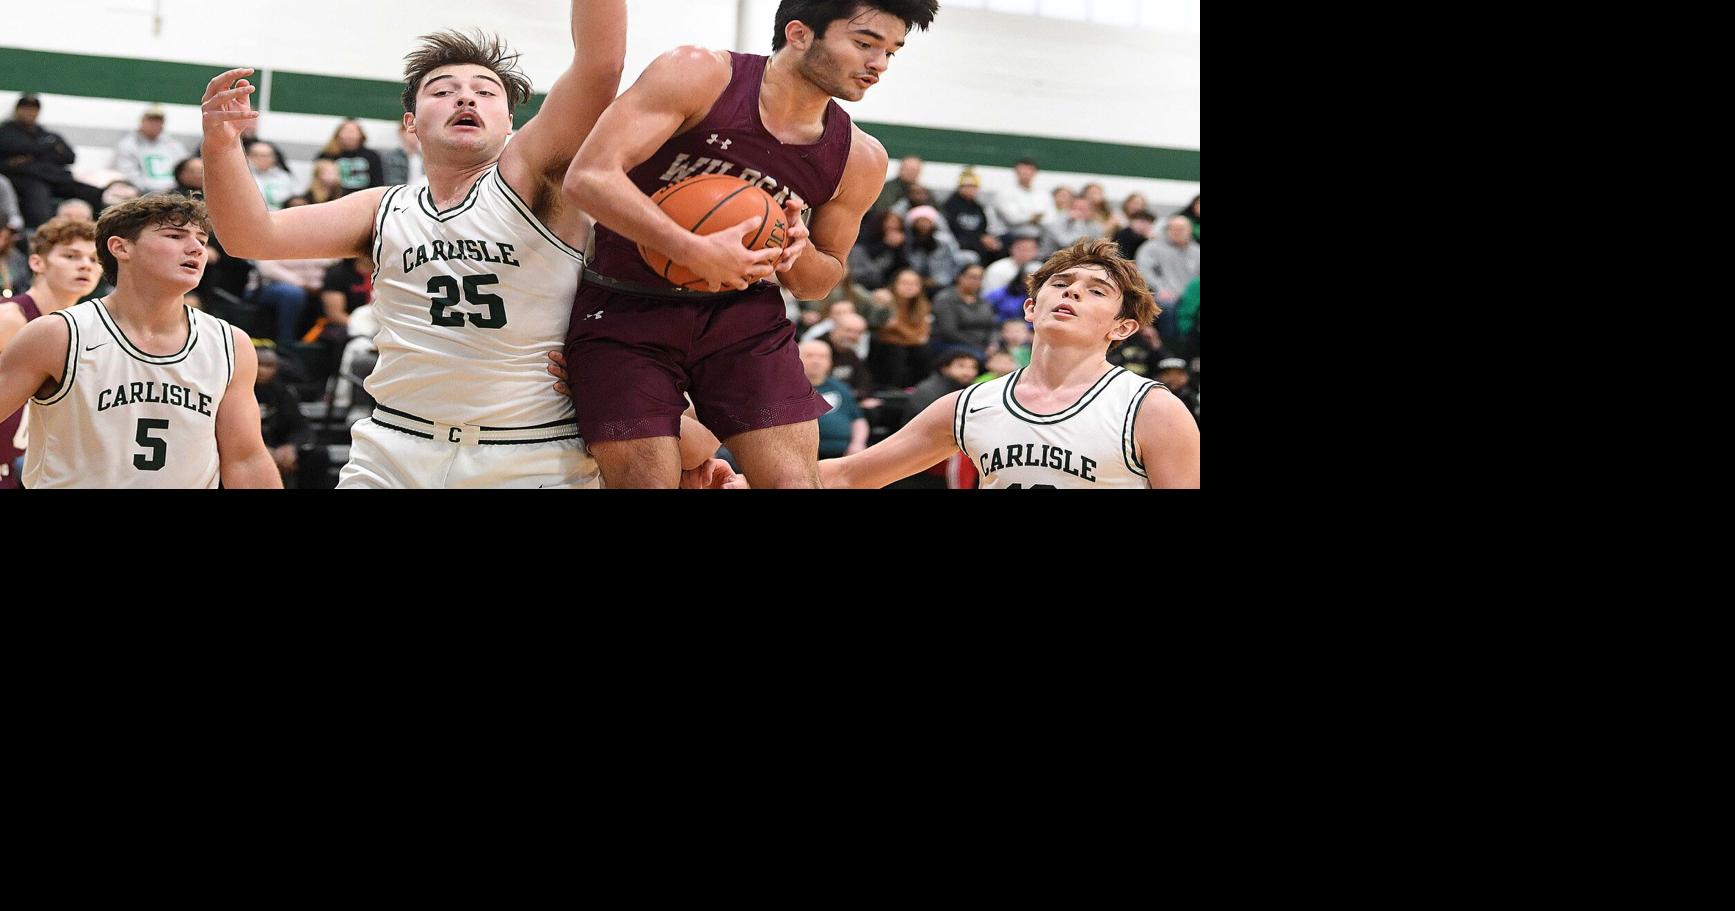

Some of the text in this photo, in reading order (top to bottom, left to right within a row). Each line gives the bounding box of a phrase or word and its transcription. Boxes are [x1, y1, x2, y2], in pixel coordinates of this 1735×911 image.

[659, 153, 809, 210] WILDCA
[402, 239, 520, 274] CARLISLE
[426, 273, 508, 329] 25
[97, 381, 213, 418] CARLISLE
[132, 417, 170, 472] 5
[448, 427, 462, 443] C
[979, 443, 1097, 483] CARLISLE
